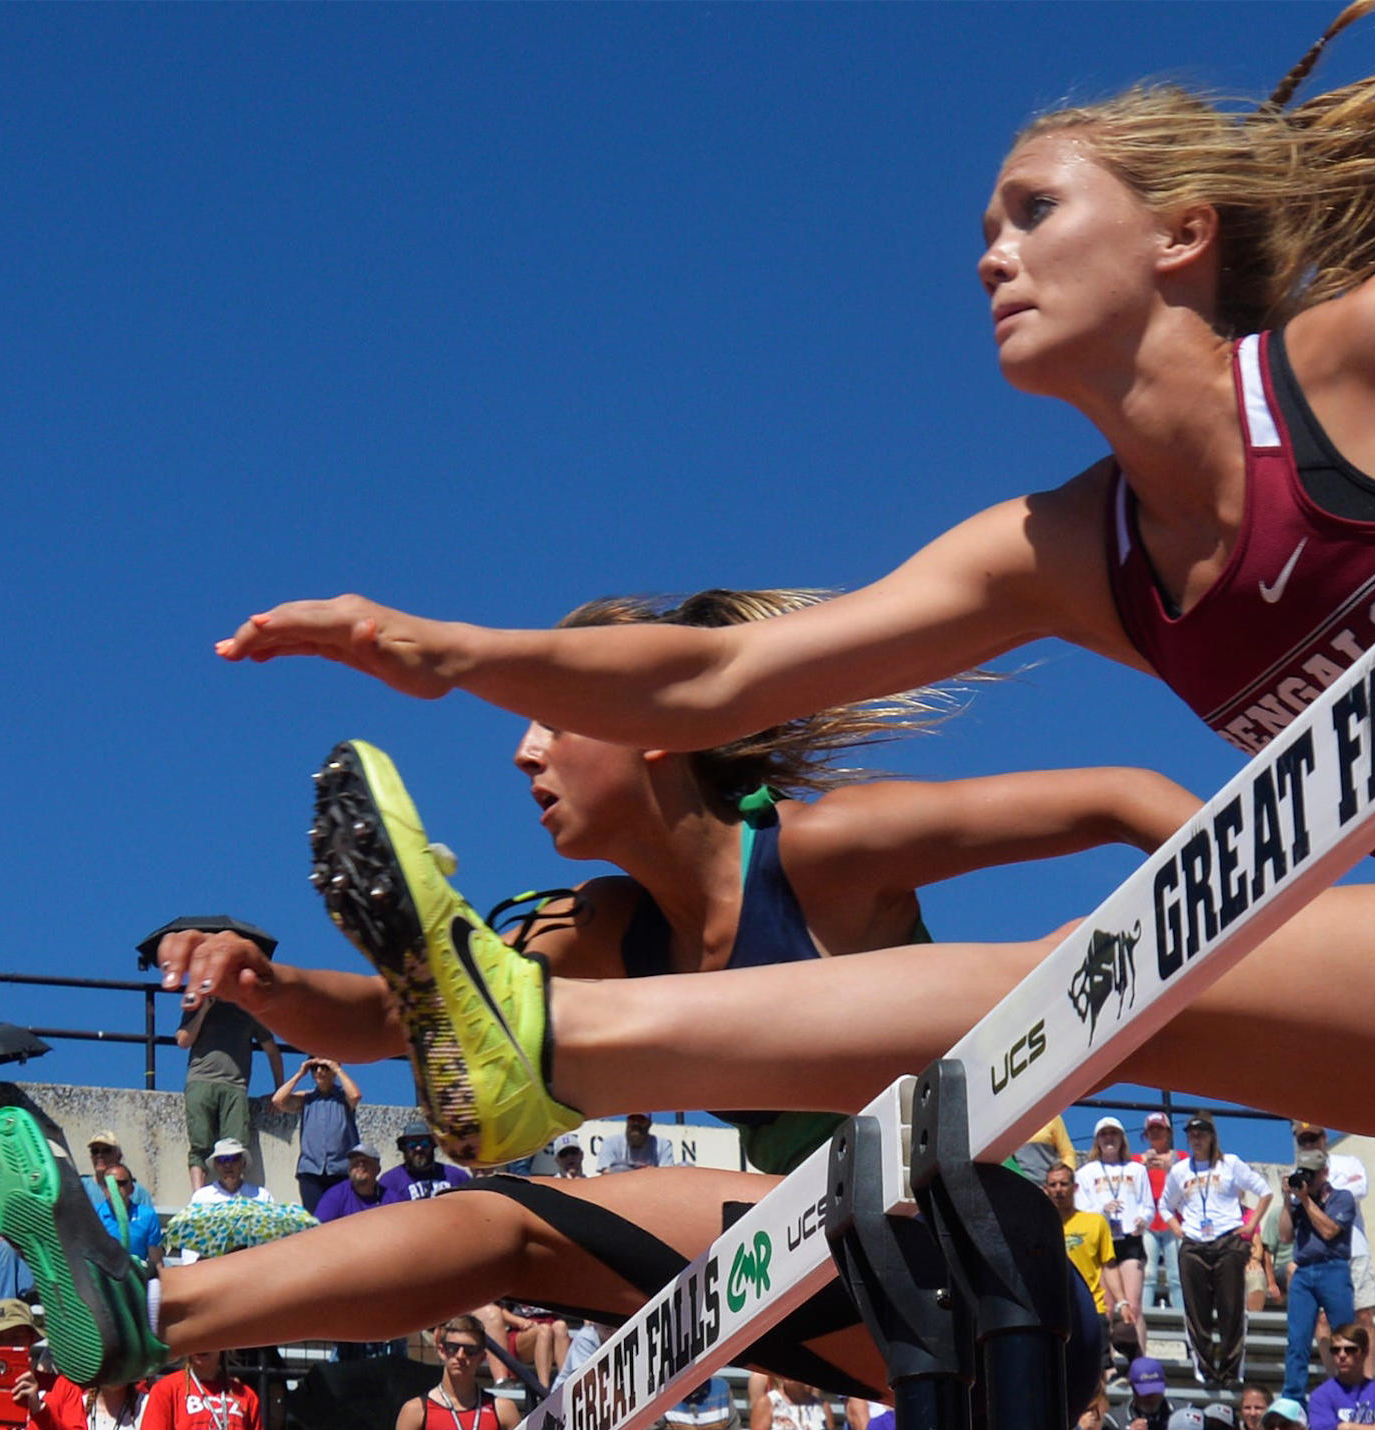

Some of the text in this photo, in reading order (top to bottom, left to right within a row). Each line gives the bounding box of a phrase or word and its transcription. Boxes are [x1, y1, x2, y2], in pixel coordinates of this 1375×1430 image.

[991, 1019, 1046, 1096] UCS
[1153, 727, 1315, 981] GREAT
[646, 1256, 721, 1396] FALLS
